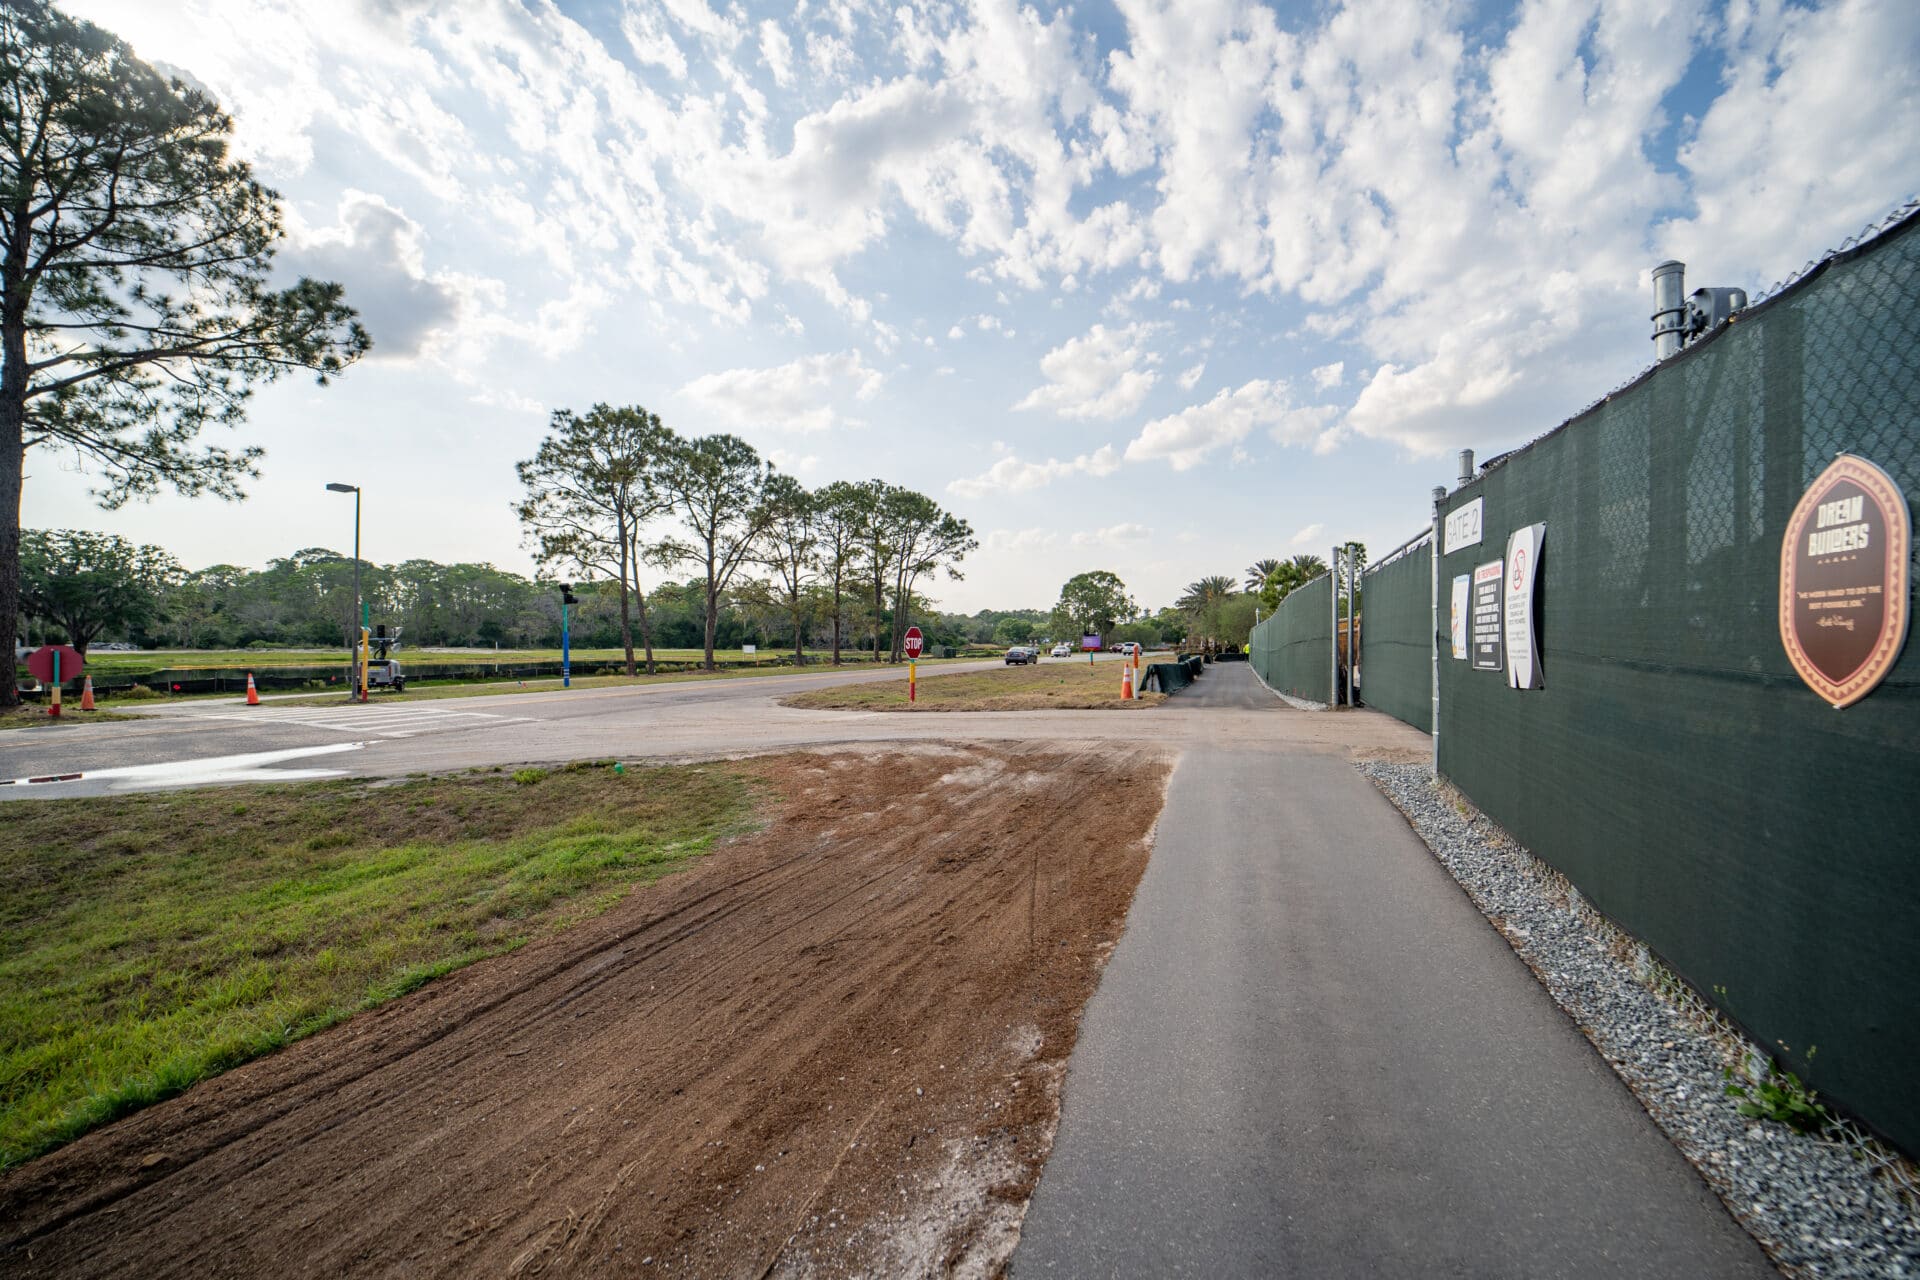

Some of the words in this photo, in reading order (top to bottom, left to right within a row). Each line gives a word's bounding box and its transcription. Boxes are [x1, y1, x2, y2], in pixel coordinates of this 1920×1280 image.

[1447, 512, 1469, 546] GATE
[1472, 508, 1479, 536] 2
[1817, 495, 1864, 528] DREAM
[1808, 523, 1870, 556] BUILDERS
[905, 637, 922, 650] STOP
